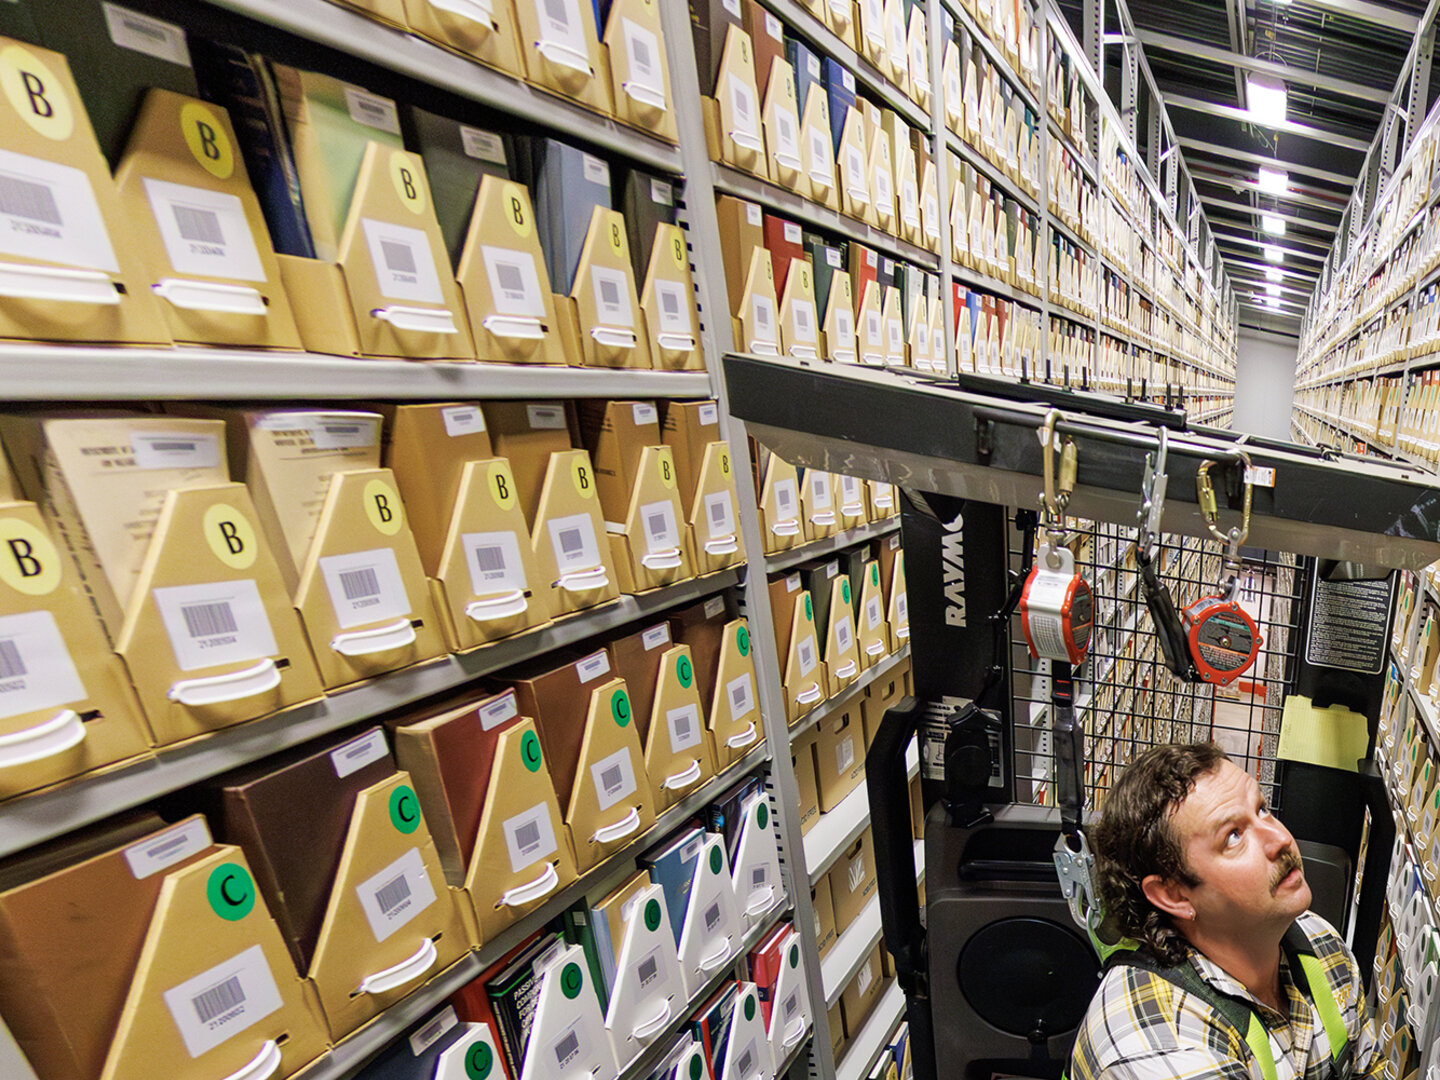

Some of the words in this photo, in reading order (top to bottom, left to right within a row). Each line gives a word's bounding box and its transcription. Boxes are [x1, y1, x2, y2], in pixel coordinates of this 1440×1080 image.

[21, 72, 52, 117] B
[200, 120, 220, 160] B
[401, 169, 416, 199] B
[512, 195, 523, 225] B
[613, 224, 620, 247] B
[674, 238, 682, 260] B
[578, 467, 588, 489] B
[663, 461, 670, 480] B
[496, 475, 508, 499] B
[375, 495, 392, 522] B
[219, 522, 243, 554] B
[8, 539, 41, 577] B
[740, 633, 747, 650] C
[681, 663, 689, 680] C
[617, 698, 626, 718] C
[527, 740, 537, 762] C
[398, 796, 415, 822] C
[221, 875, 246, 906] C
[567, 970, 578, 989] C
[472, 1049, 488, 1071] C
